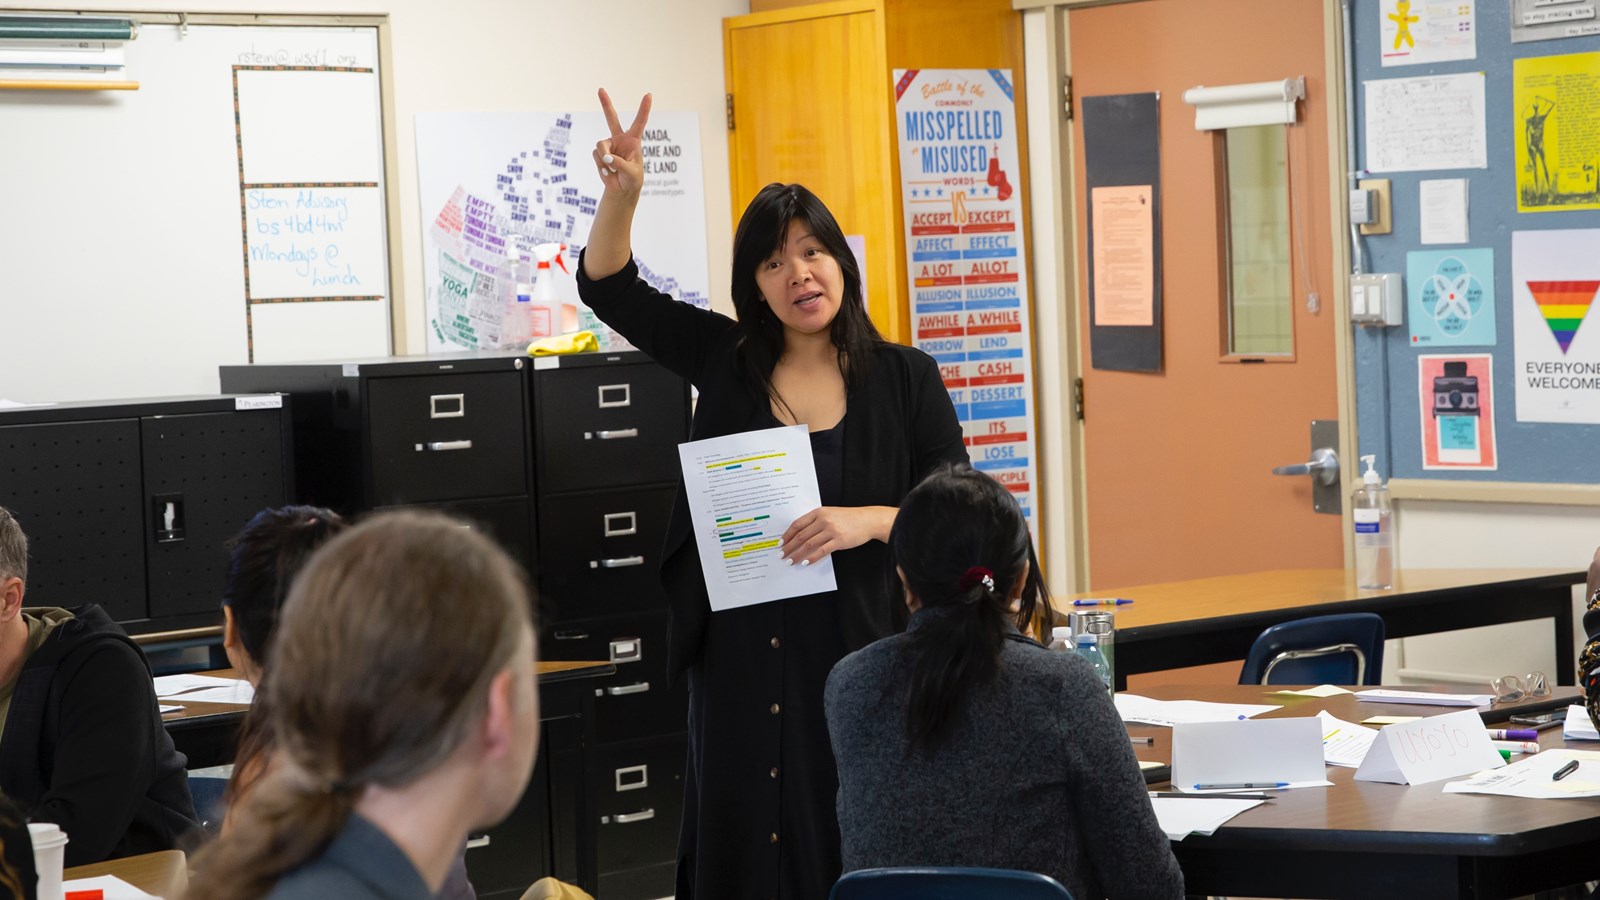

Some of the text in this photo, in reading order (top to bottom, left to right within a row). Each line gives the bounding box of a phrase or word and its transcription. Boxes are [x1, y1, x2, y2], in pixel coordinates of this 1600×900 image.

[921, 80, 985, 99] Battle of the
[906, 110, 1003, 141] MISSPELLED
[642, 145, 682, 158] OME AND
[922, 146, 987, 174] MISUSED
[654, 161, 678, 174] LAND
[942, 177, 976, 186] WORDS
[296, 190, 348, 222] Advisory
[466, 194, 496, 213] EMPTY
[950, 190, 967, 224] VS
[465, 204, 494, 222] EMPTY
[912, 212, 952, 226] ACCEPT
[968, 210, 1010, 224] EXCEPT
[916, 238, 954, 250] AFFECT
[970, 236, 1010, 249] EFFECT
[250, 243, 318, 277] Mondays
[922, 263, 953, 276] A LOT
[972, 261, 1009, 274] ALLOT
[442, 276, 468, 298] YOGA
[966, 286, 1016, 300] ILLUSION
[916, 288, 962, 302] ALLUSION
[918, 314, 959, 328] AWHILE
[967, 311, 1020, 326] A WHILE
[919, 340, 964, 352] BORROW
[980, 336, 1008, 350] LEND
[940, 365, 961, 378] CHE
[978, 362, 1013, 376] CASH
[1528, 377, 1600, 390] WELCOME
[971, 386, 1023, 402] DESSERT
[988, 421, 1006, 434] ITS
[984, 446, 1015, 460] LOSE
[992, 471, 1026, 482] NCIPLE
